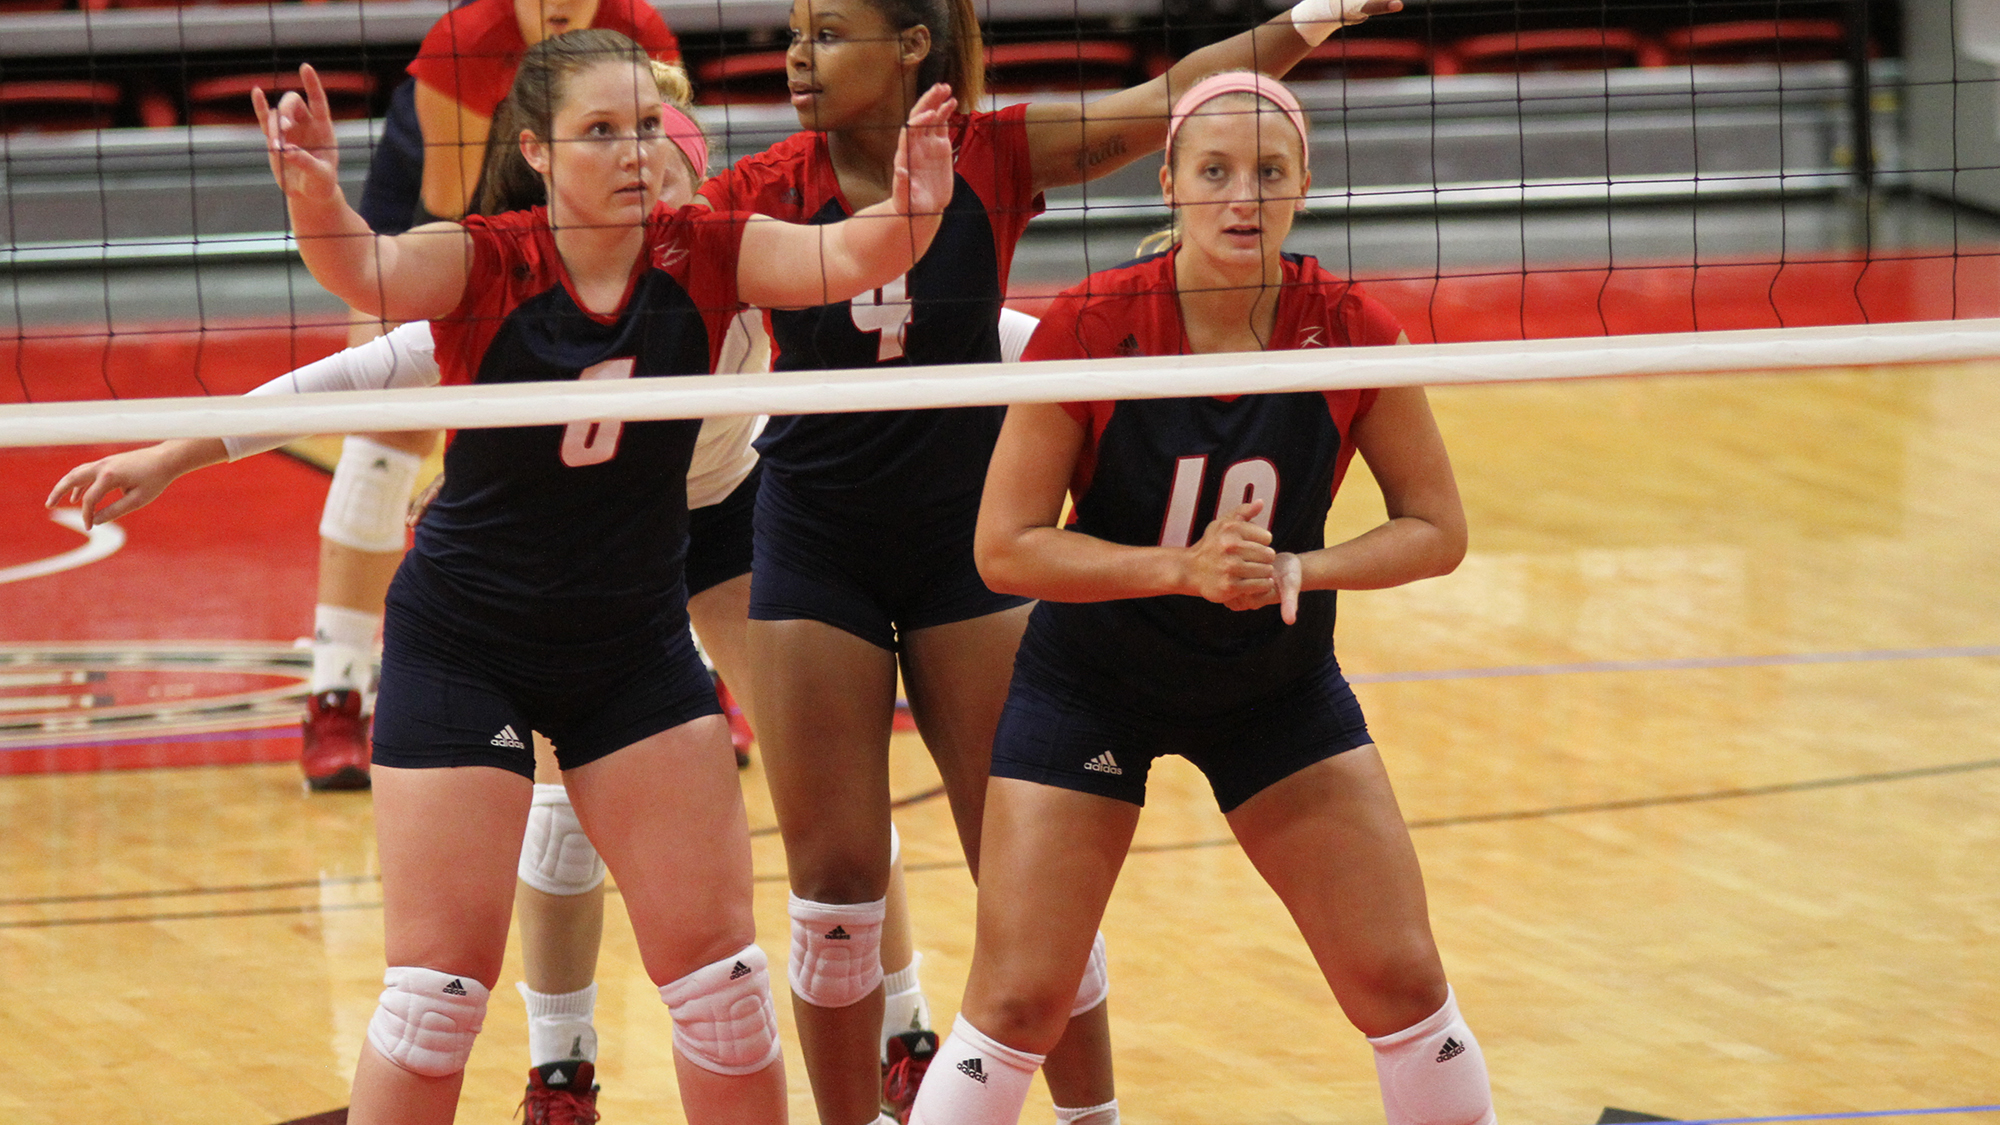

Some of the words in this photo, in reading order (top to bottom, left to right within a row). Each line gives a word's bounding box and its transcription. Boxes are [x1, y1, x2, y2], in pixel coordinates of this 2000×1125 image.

[848, 271, 914, 363] 4
[490, 737, 525, 750] adidas
[1083, 761, 1123, 776] adidas
[1435, 1040, 1466, 1063] adidas
[956, 1062, 989, 1084] adidas
